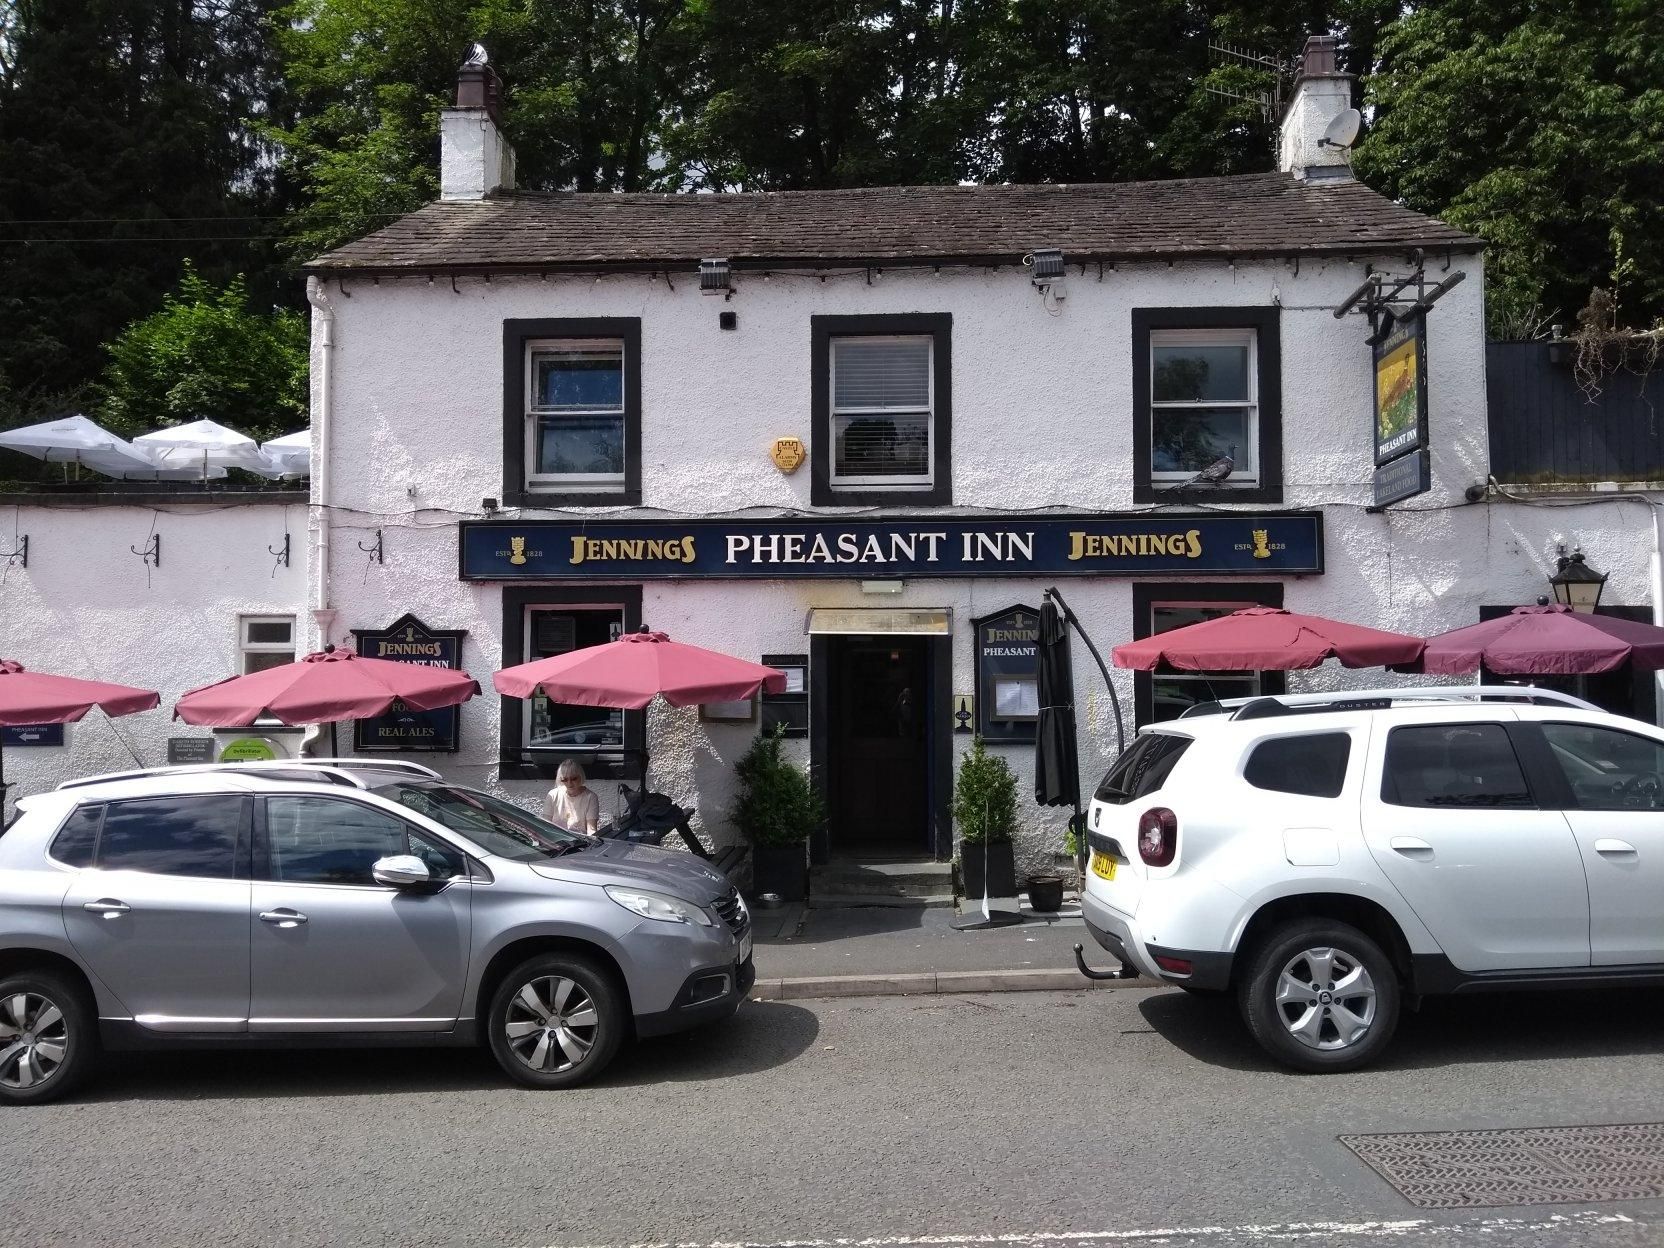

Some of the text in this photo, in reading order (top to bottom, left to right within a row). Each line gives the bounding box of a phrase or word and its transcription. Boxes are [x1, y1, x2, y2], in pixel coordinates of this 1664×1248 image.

[1379, 427, 1417, 456] PHEASANT INN
[569, 535, 696, 565] JENNINGS
[725, 532, 1035, 564] PHEASANT INN
[1067, 529, 1202, 560] JENNINGS
[987, 629, 1039, 643] JENNIN
[378, 642, 442, 657] JENNINGS
[983, 647, 1036, 656] PHEASANT
[430, 660, 450, 669] INN
[378, 727, 435, 737] REAL ALES
